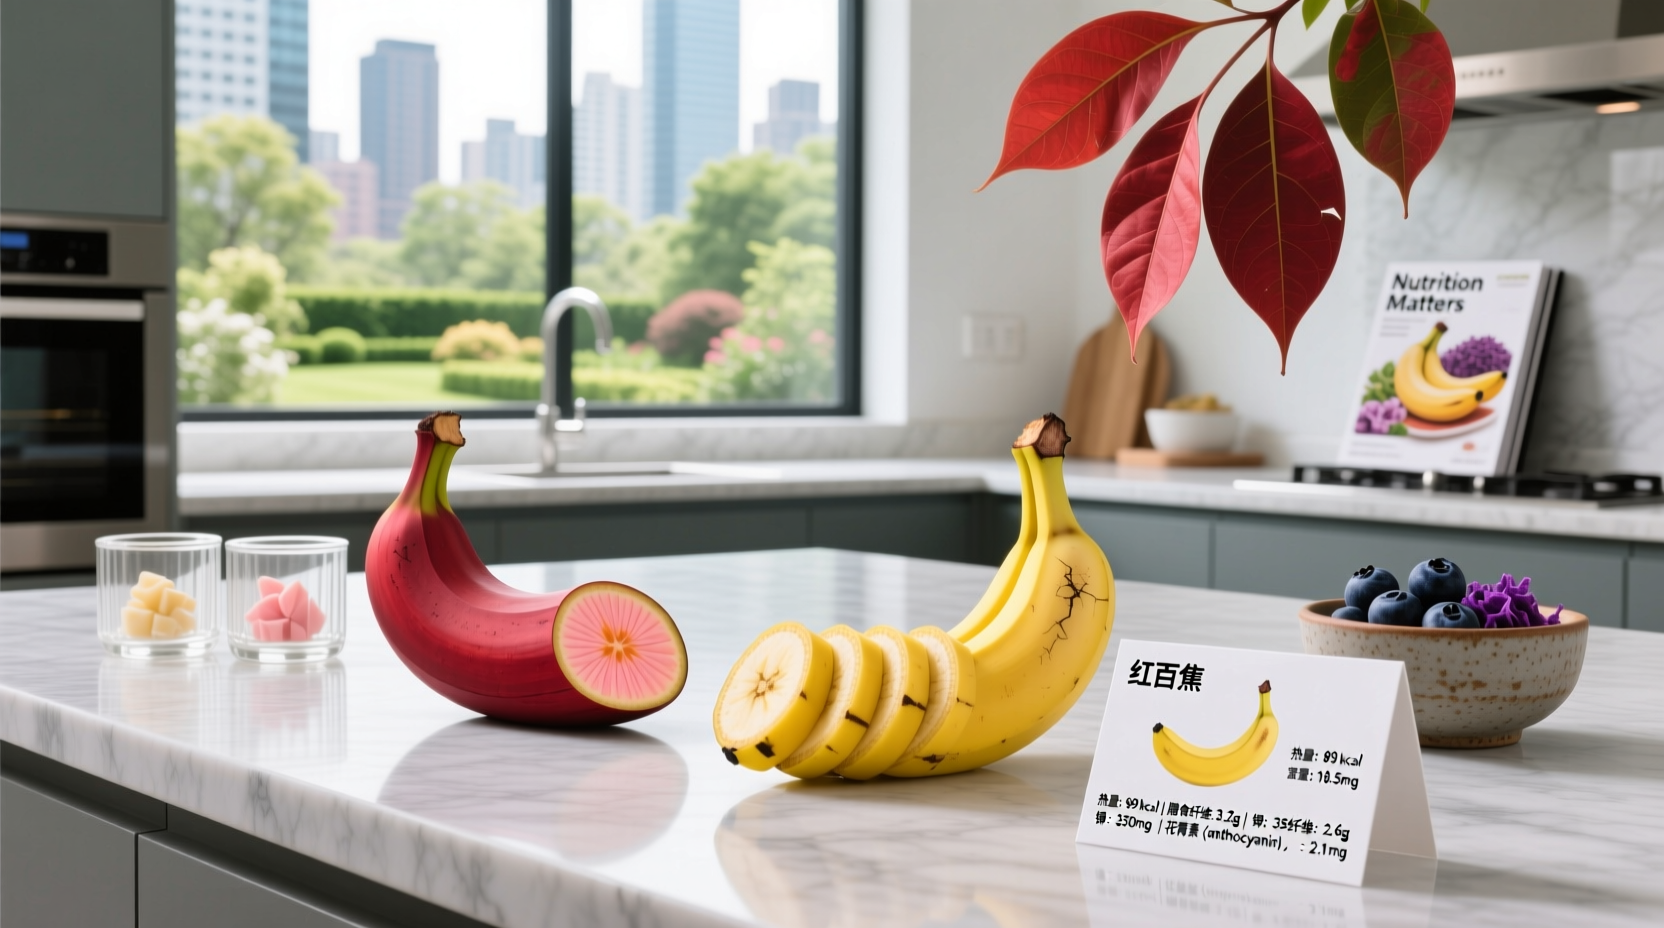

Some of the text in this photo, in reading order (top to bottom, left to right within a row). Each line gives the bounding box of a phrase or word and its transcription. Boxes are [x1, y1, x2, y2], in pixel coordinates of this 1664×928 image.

[1391, 271, 1484, 292] Nutrition
[1386, 294, 1465, 313] Matters
[1127, 658, 1205, 692] 红百焦
[1308, 840, 1348, 862] 2.1mg
